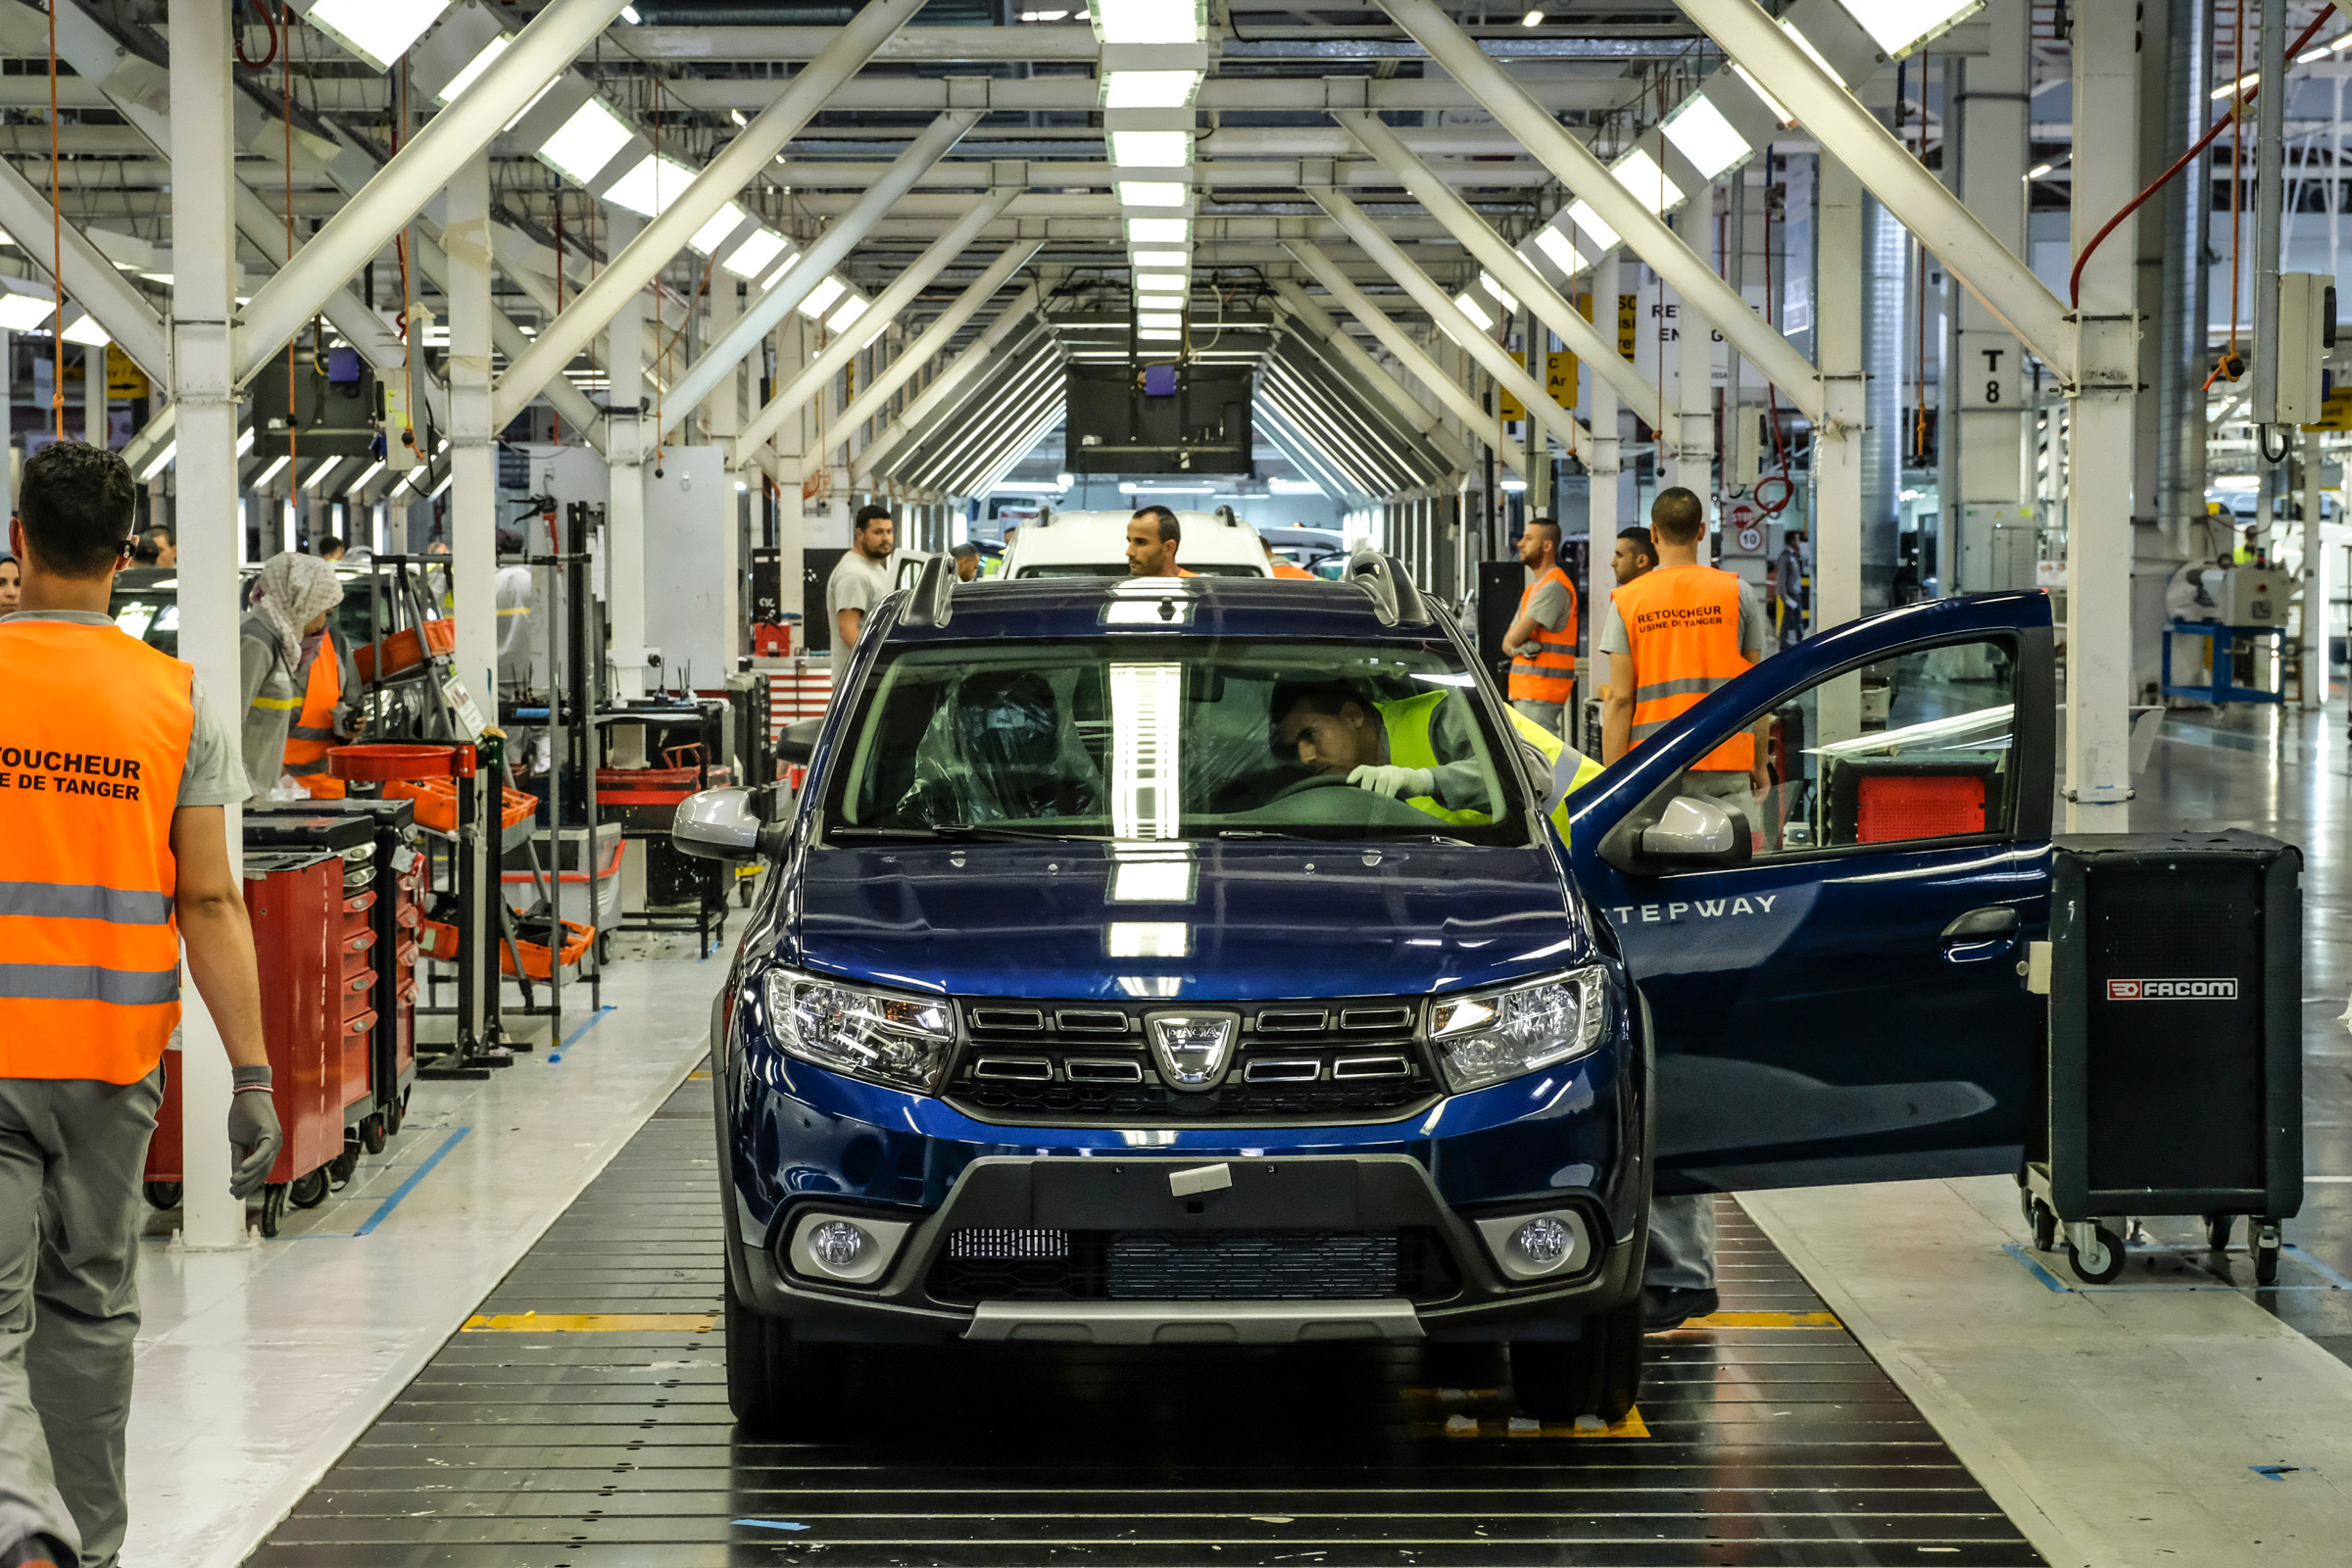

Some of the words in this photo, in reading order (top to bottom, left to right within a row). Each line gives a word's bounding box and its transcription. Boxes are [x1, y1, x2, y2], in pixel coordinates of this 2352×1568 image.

[1982, 350, 2004, 372] T
[1986, 380, 1999, 404] 8
[1743, 533, 1757, 545] 10
[1638, 606, 1721, 623] RETOUCHEUR
[1639, 620, 1669, 633] USINE
[1685, 616, 1723, 628] TANGER
[0, 746, 141, 780] OUCHEUR
[19, 773, 46, 791] DE
[53, 776, 140, 802] TANGER
[1600, 895, 1777, 924] TEPWAY
[2143, 982, 2234, 997] FACOM
